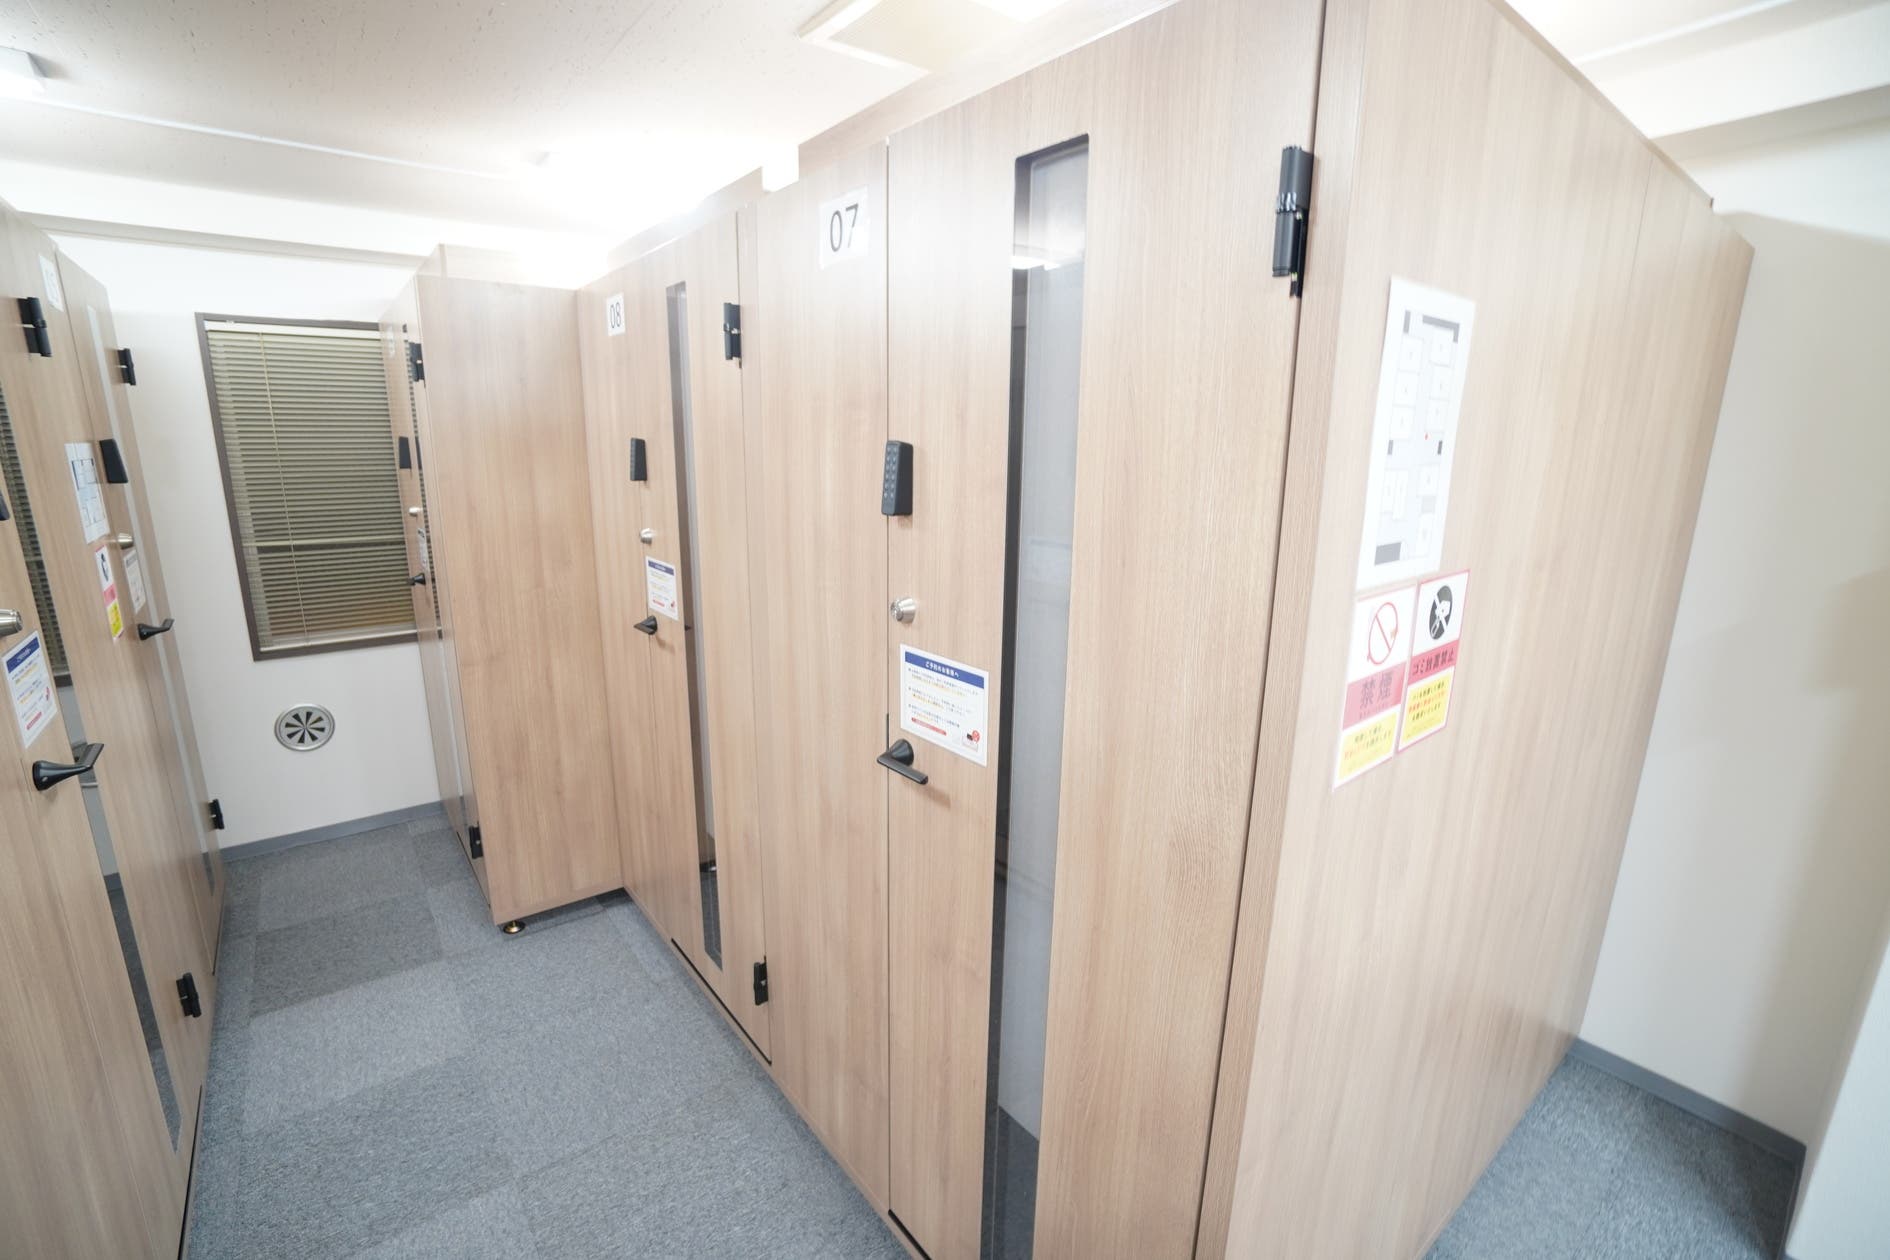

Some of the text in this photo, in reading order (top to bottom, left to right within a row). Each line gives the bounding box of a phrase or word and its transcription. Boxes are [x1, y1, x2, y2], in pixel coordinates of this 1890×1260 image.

[830, 203, 859, 252] 07
[610, 302, 621, 329] 08
[1412, 647, 1455, 676] ゴミ放置禁止
[1360, 670, 1394, 710] 禁煙
